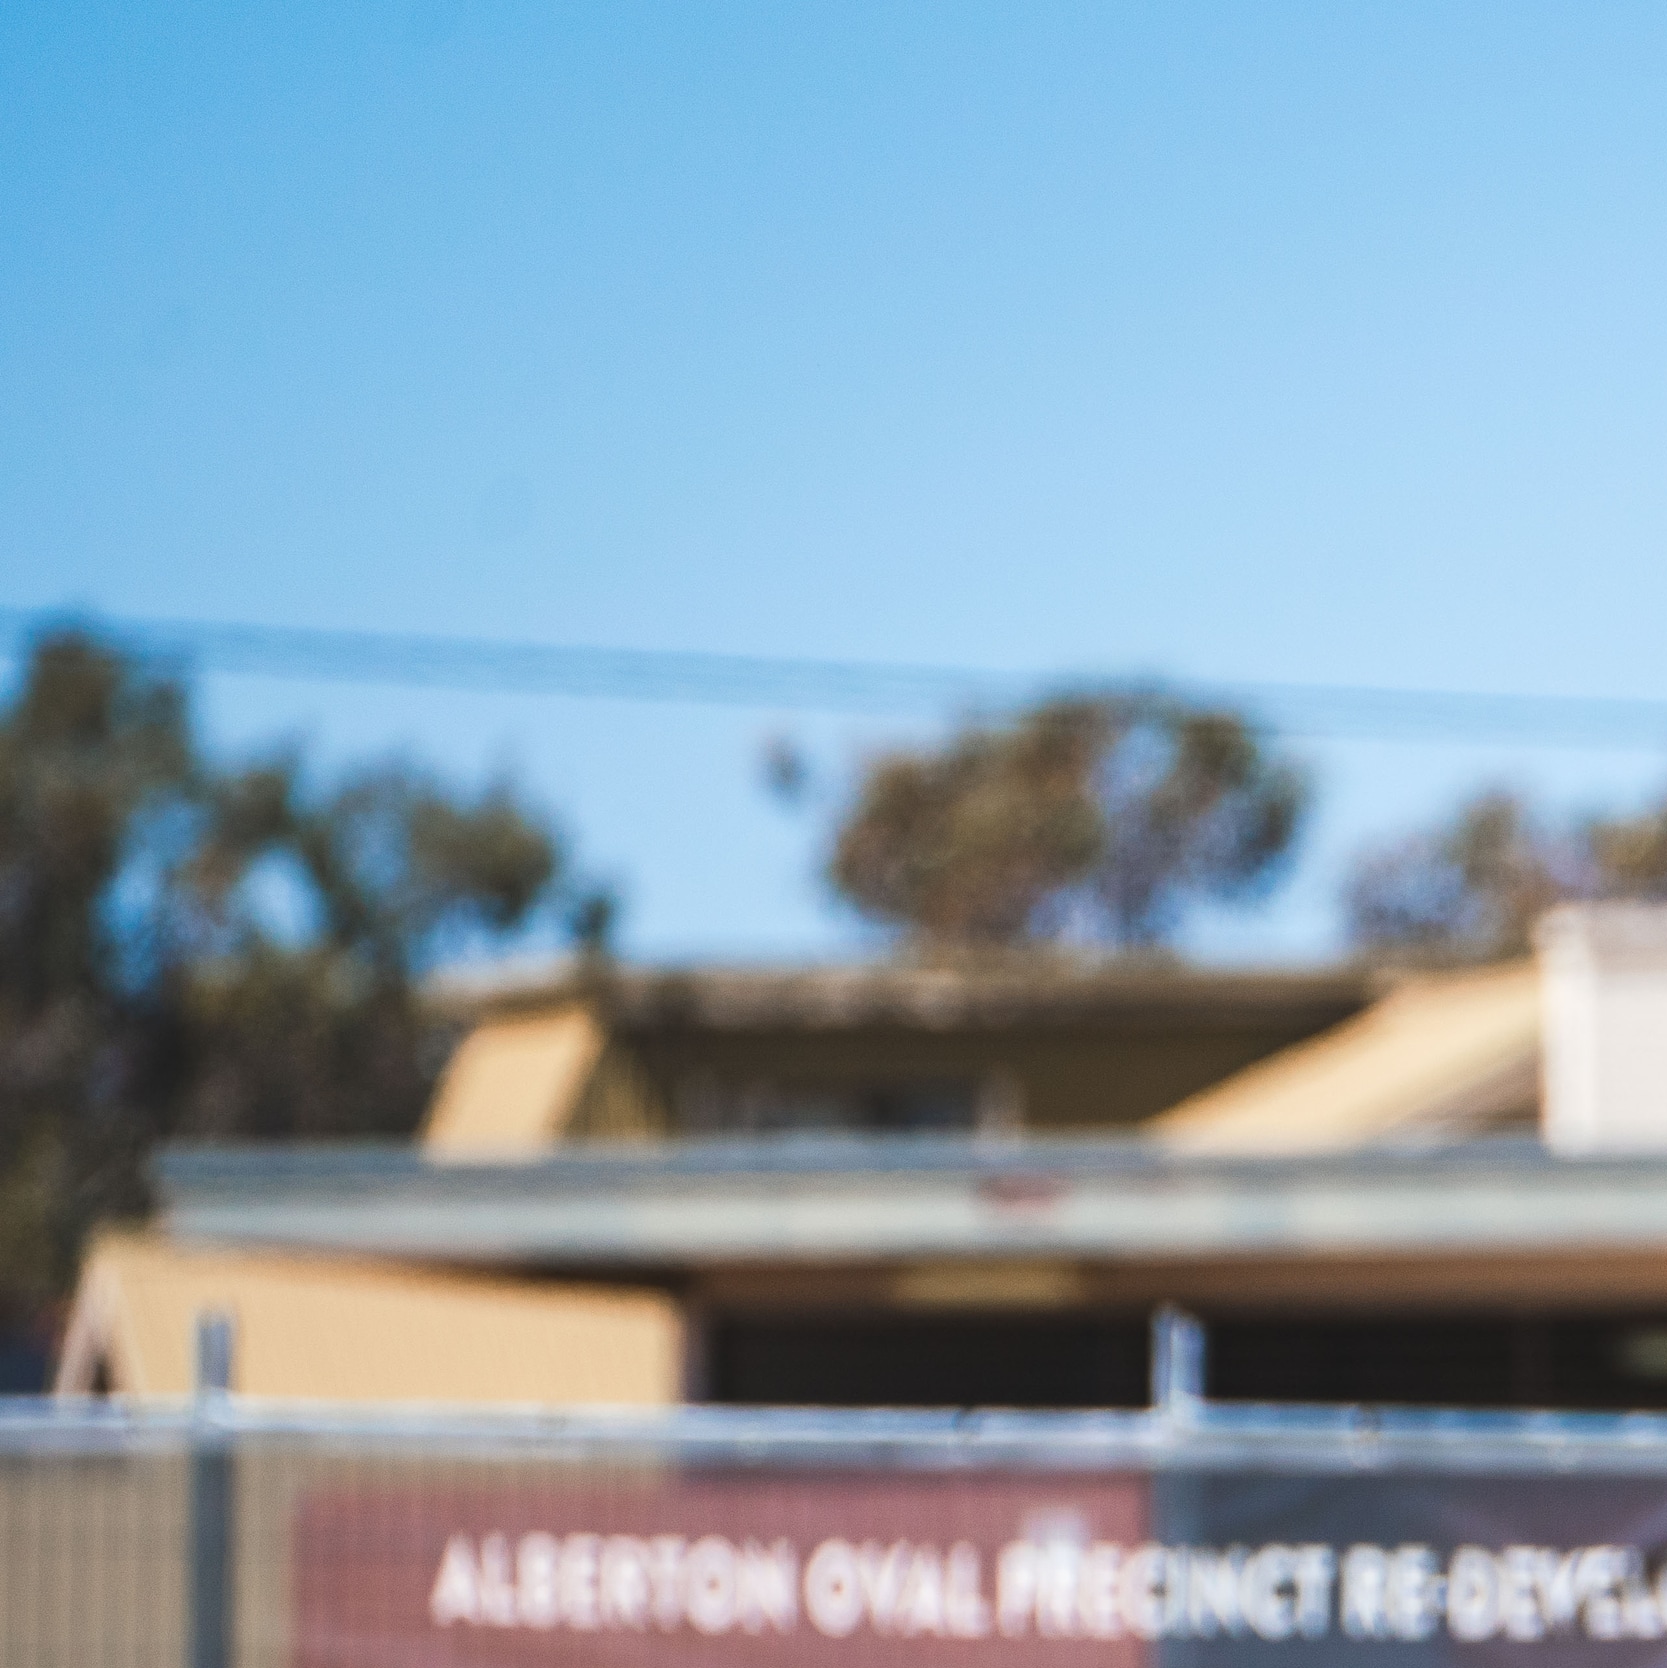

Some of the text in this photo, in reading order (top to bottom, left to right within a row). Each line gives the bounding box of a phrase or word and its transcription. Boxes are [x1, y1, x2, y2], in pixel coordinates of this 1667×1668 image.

[430, 1531, 800, 1635] ALBERTON
[804, 1536, 990, 1638] OVAL
[997, 1541, 1339, 1642] PRECINCT
